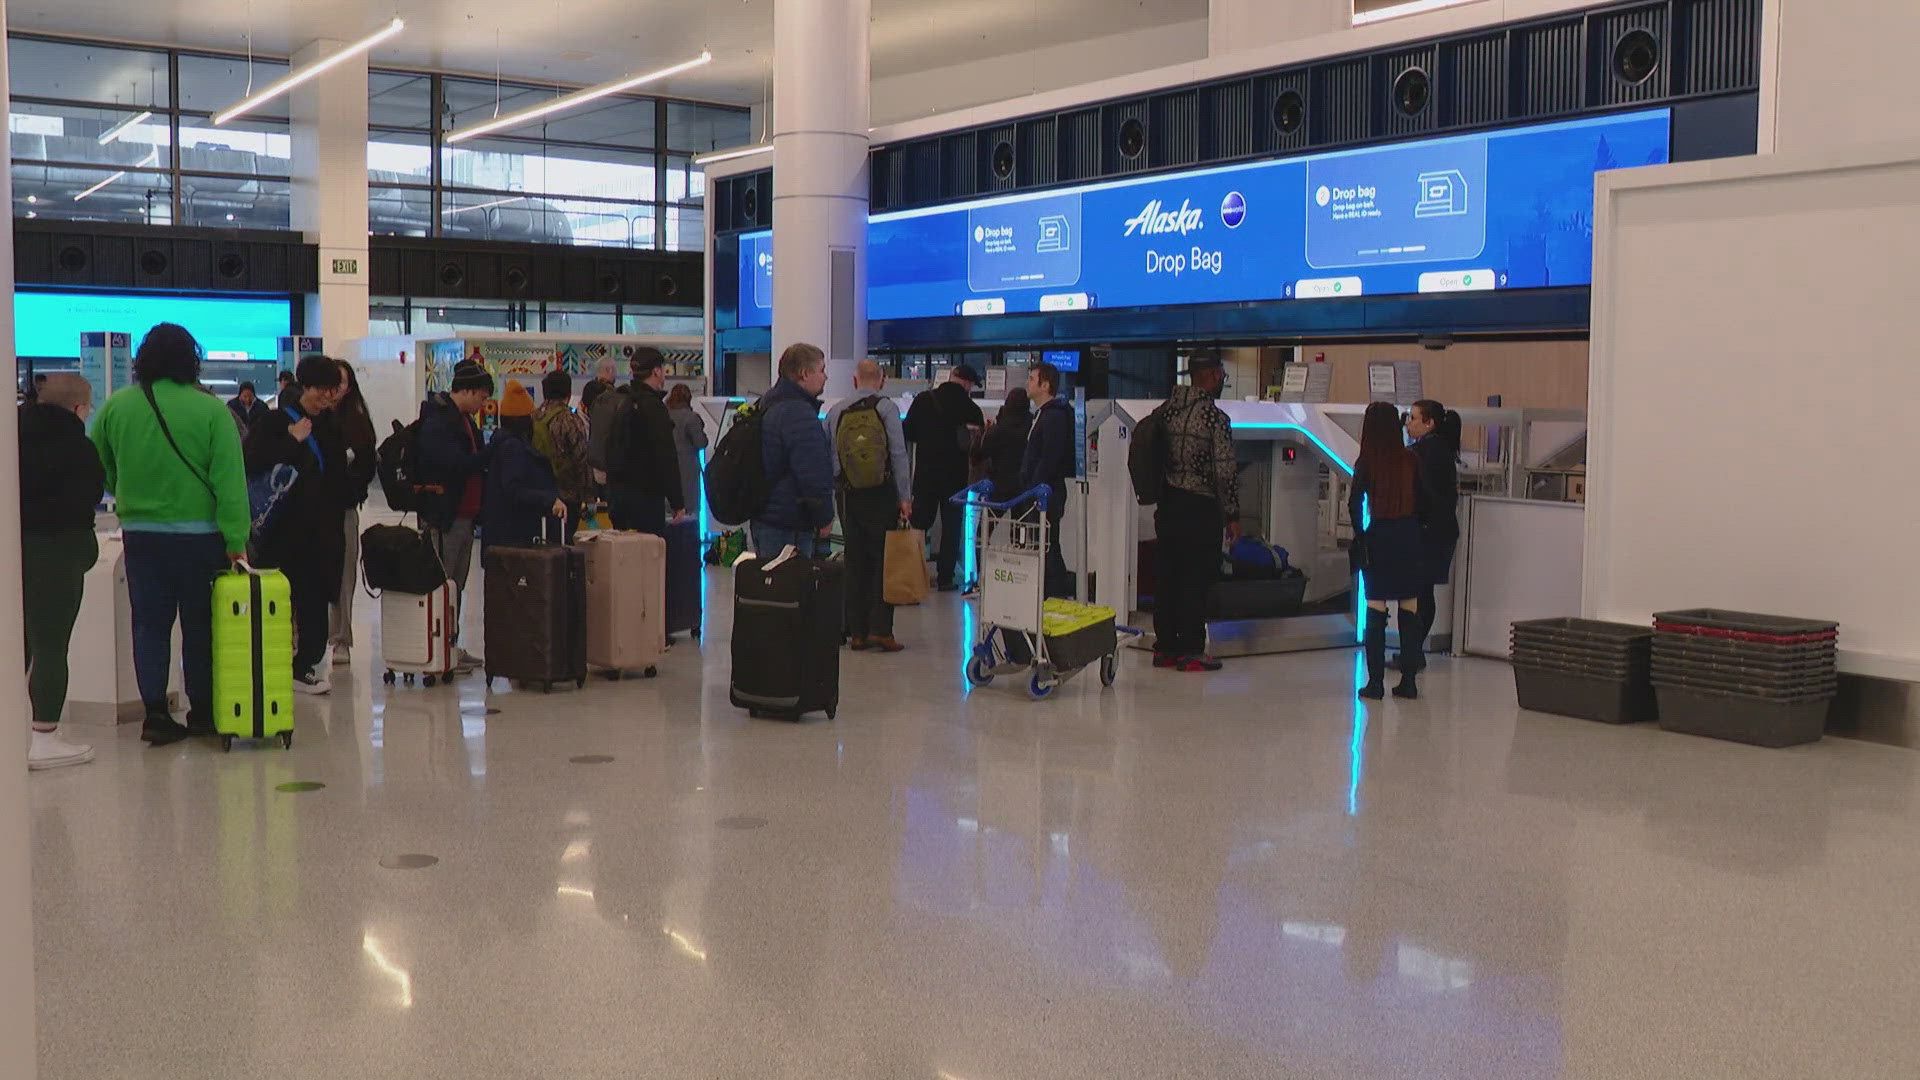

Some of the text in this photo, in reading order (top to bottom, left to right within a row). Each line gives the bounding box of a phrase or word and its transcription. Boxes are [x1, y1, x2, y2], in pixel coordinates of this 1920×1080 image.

[1332, 187, 1356, 201] Drop
[1357, 184, 1376, 200] bag
[985, 225, 1013, 239] Drop bag
[336, 260, 354, 273] EXIT
[1146, 246, 1222, 277] Drop Bag
[1439, 276, 1458, 288] Open
[1500, 273, 1507, 286] 9
[1285, 285, 1291, 296] 8
[994, 568, 1014, 584] SEA
